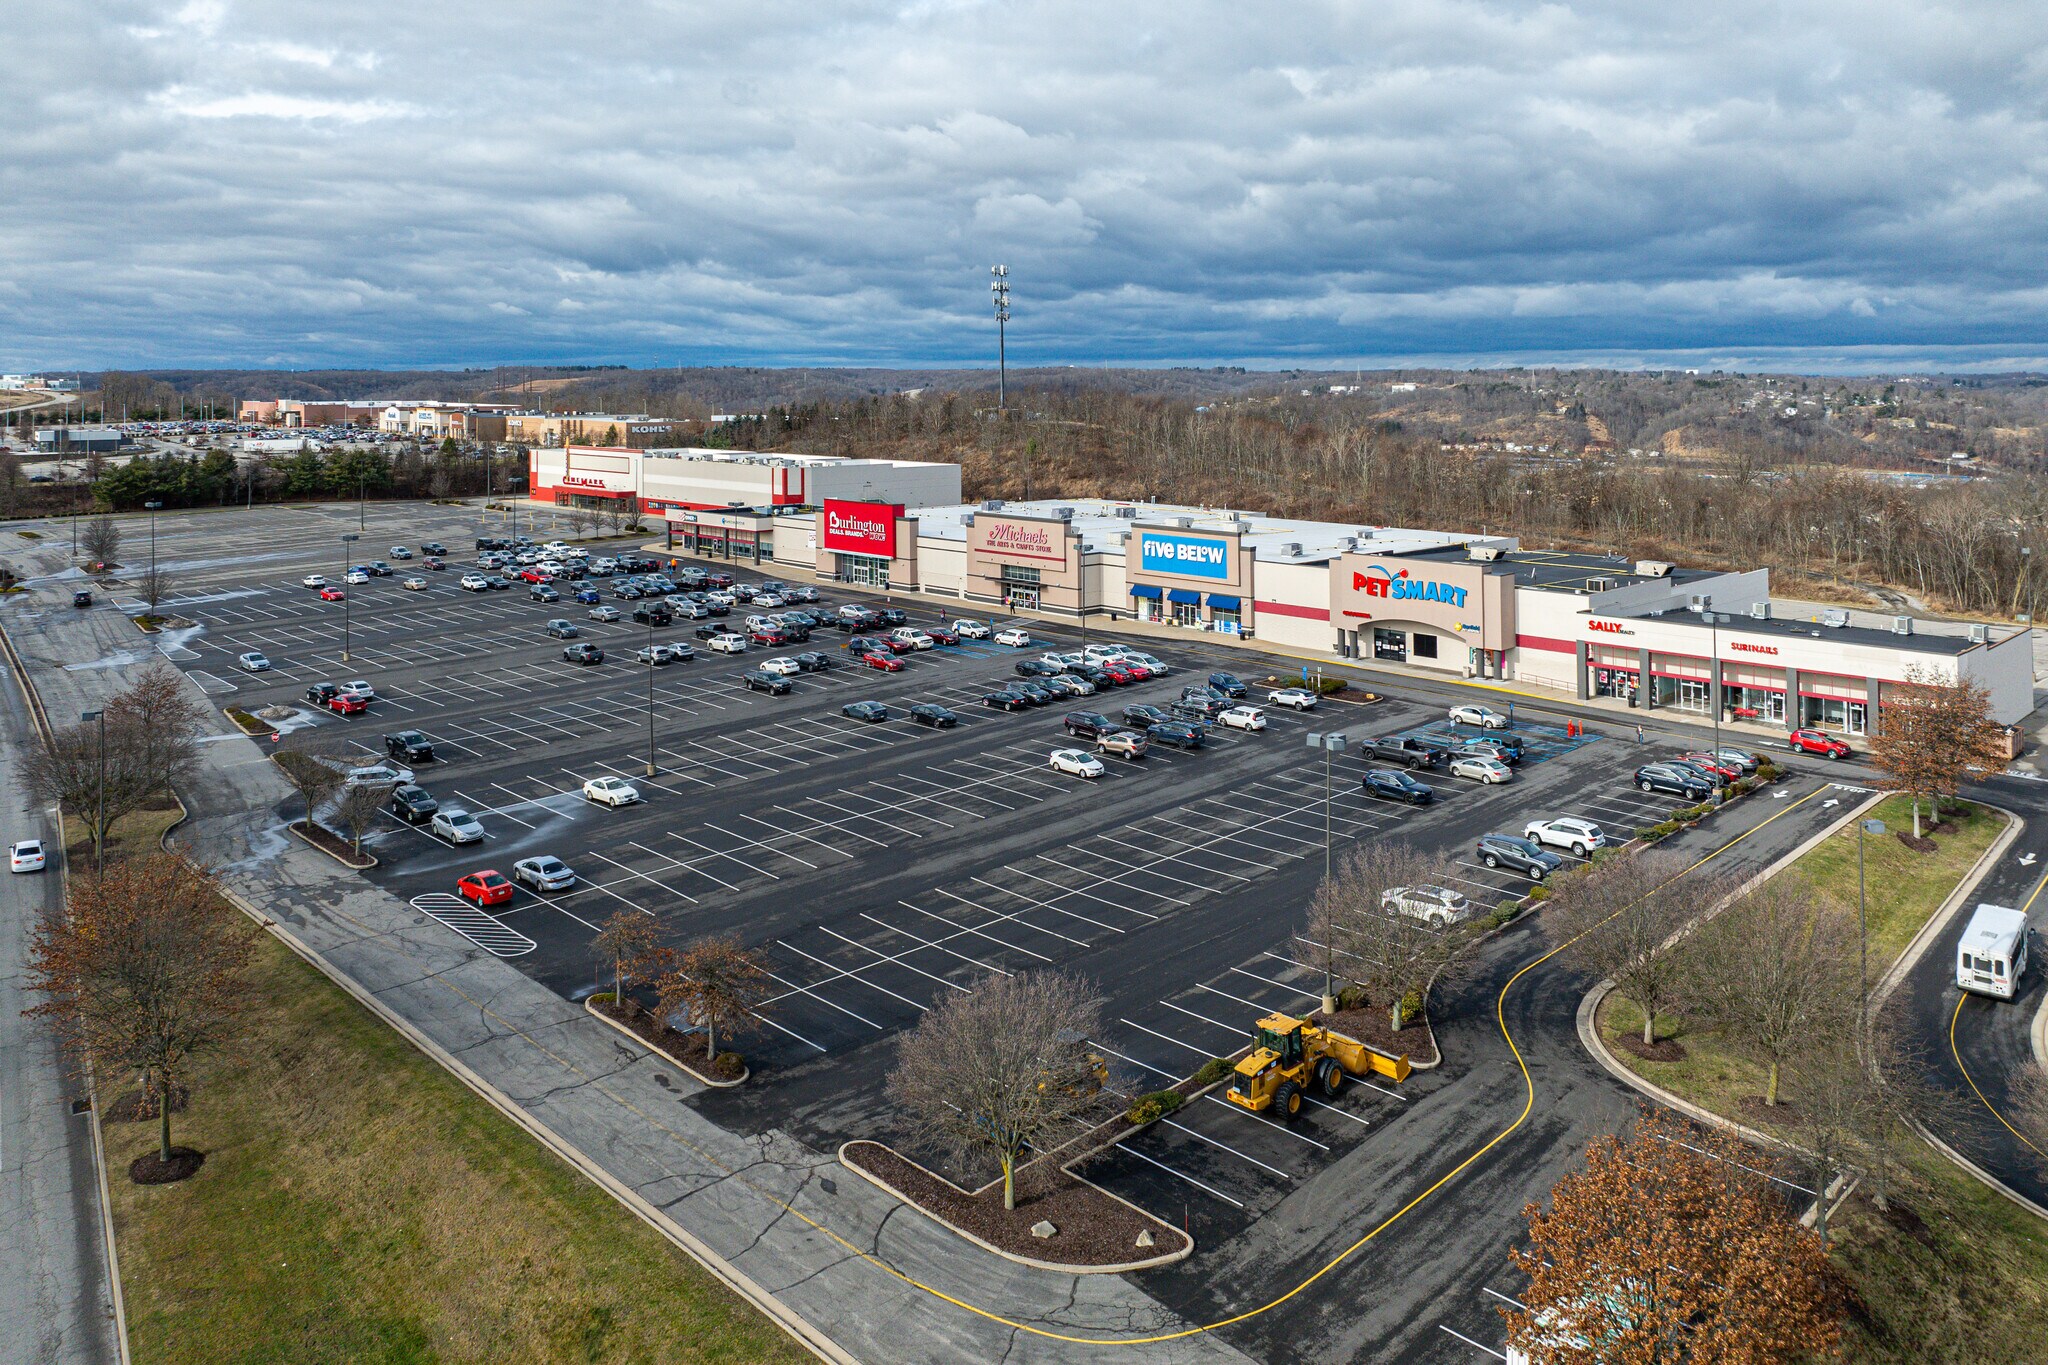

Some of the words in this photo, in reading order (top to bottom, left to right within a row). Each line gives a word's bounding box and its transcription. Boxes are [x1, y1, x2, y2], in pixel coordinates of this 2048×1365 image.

[829, 511, 885, 536] Burlington
[989, 524, 1048, 545] Michaels
[1016, 543, 1035, 551] CRAFTS
[1353, 570, 1468, 608] PETSMART
[1588, 620, 1623, 634] SALLY
